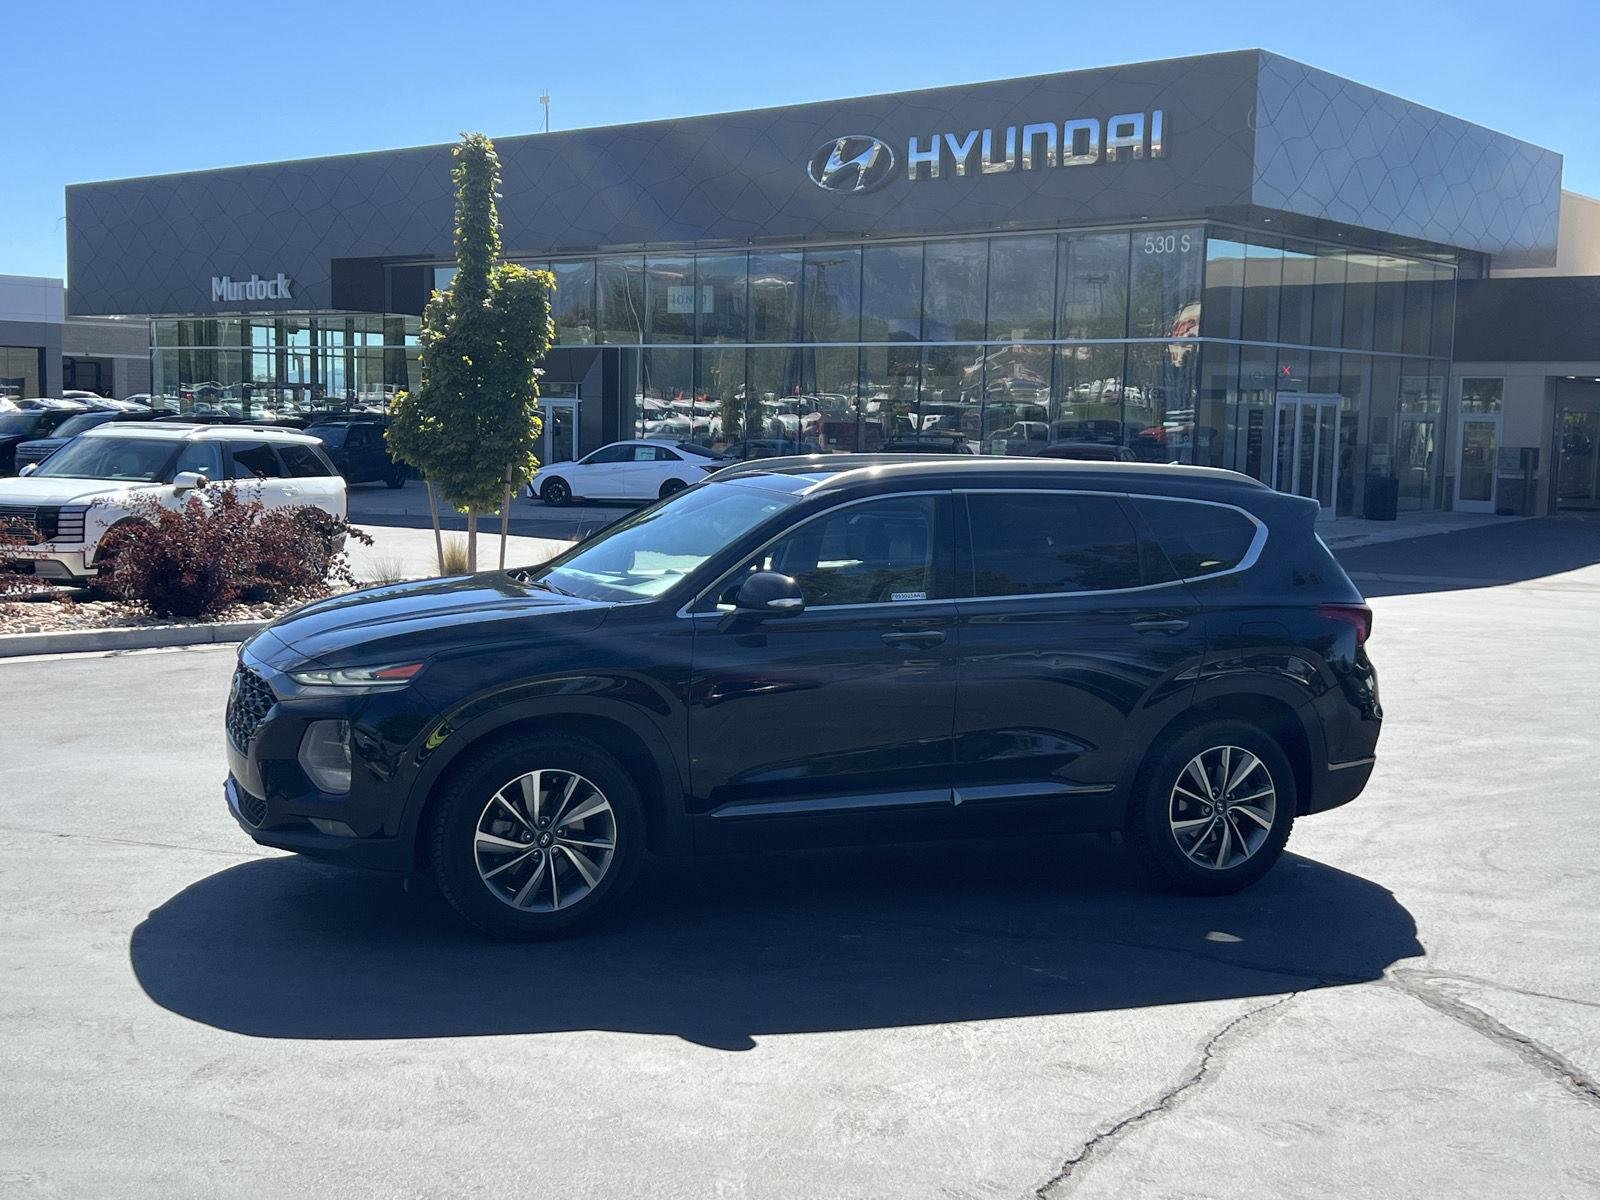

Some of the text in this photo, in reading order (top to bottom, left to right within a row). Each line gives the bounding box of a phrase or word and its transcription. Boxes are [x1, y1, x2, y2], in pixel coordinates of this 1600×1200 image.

[907, 109, 1164, 181] HYUNDAI
[1144, 234, 1191, 254] 530 S
[211, 273, 292, 302] Murdock
